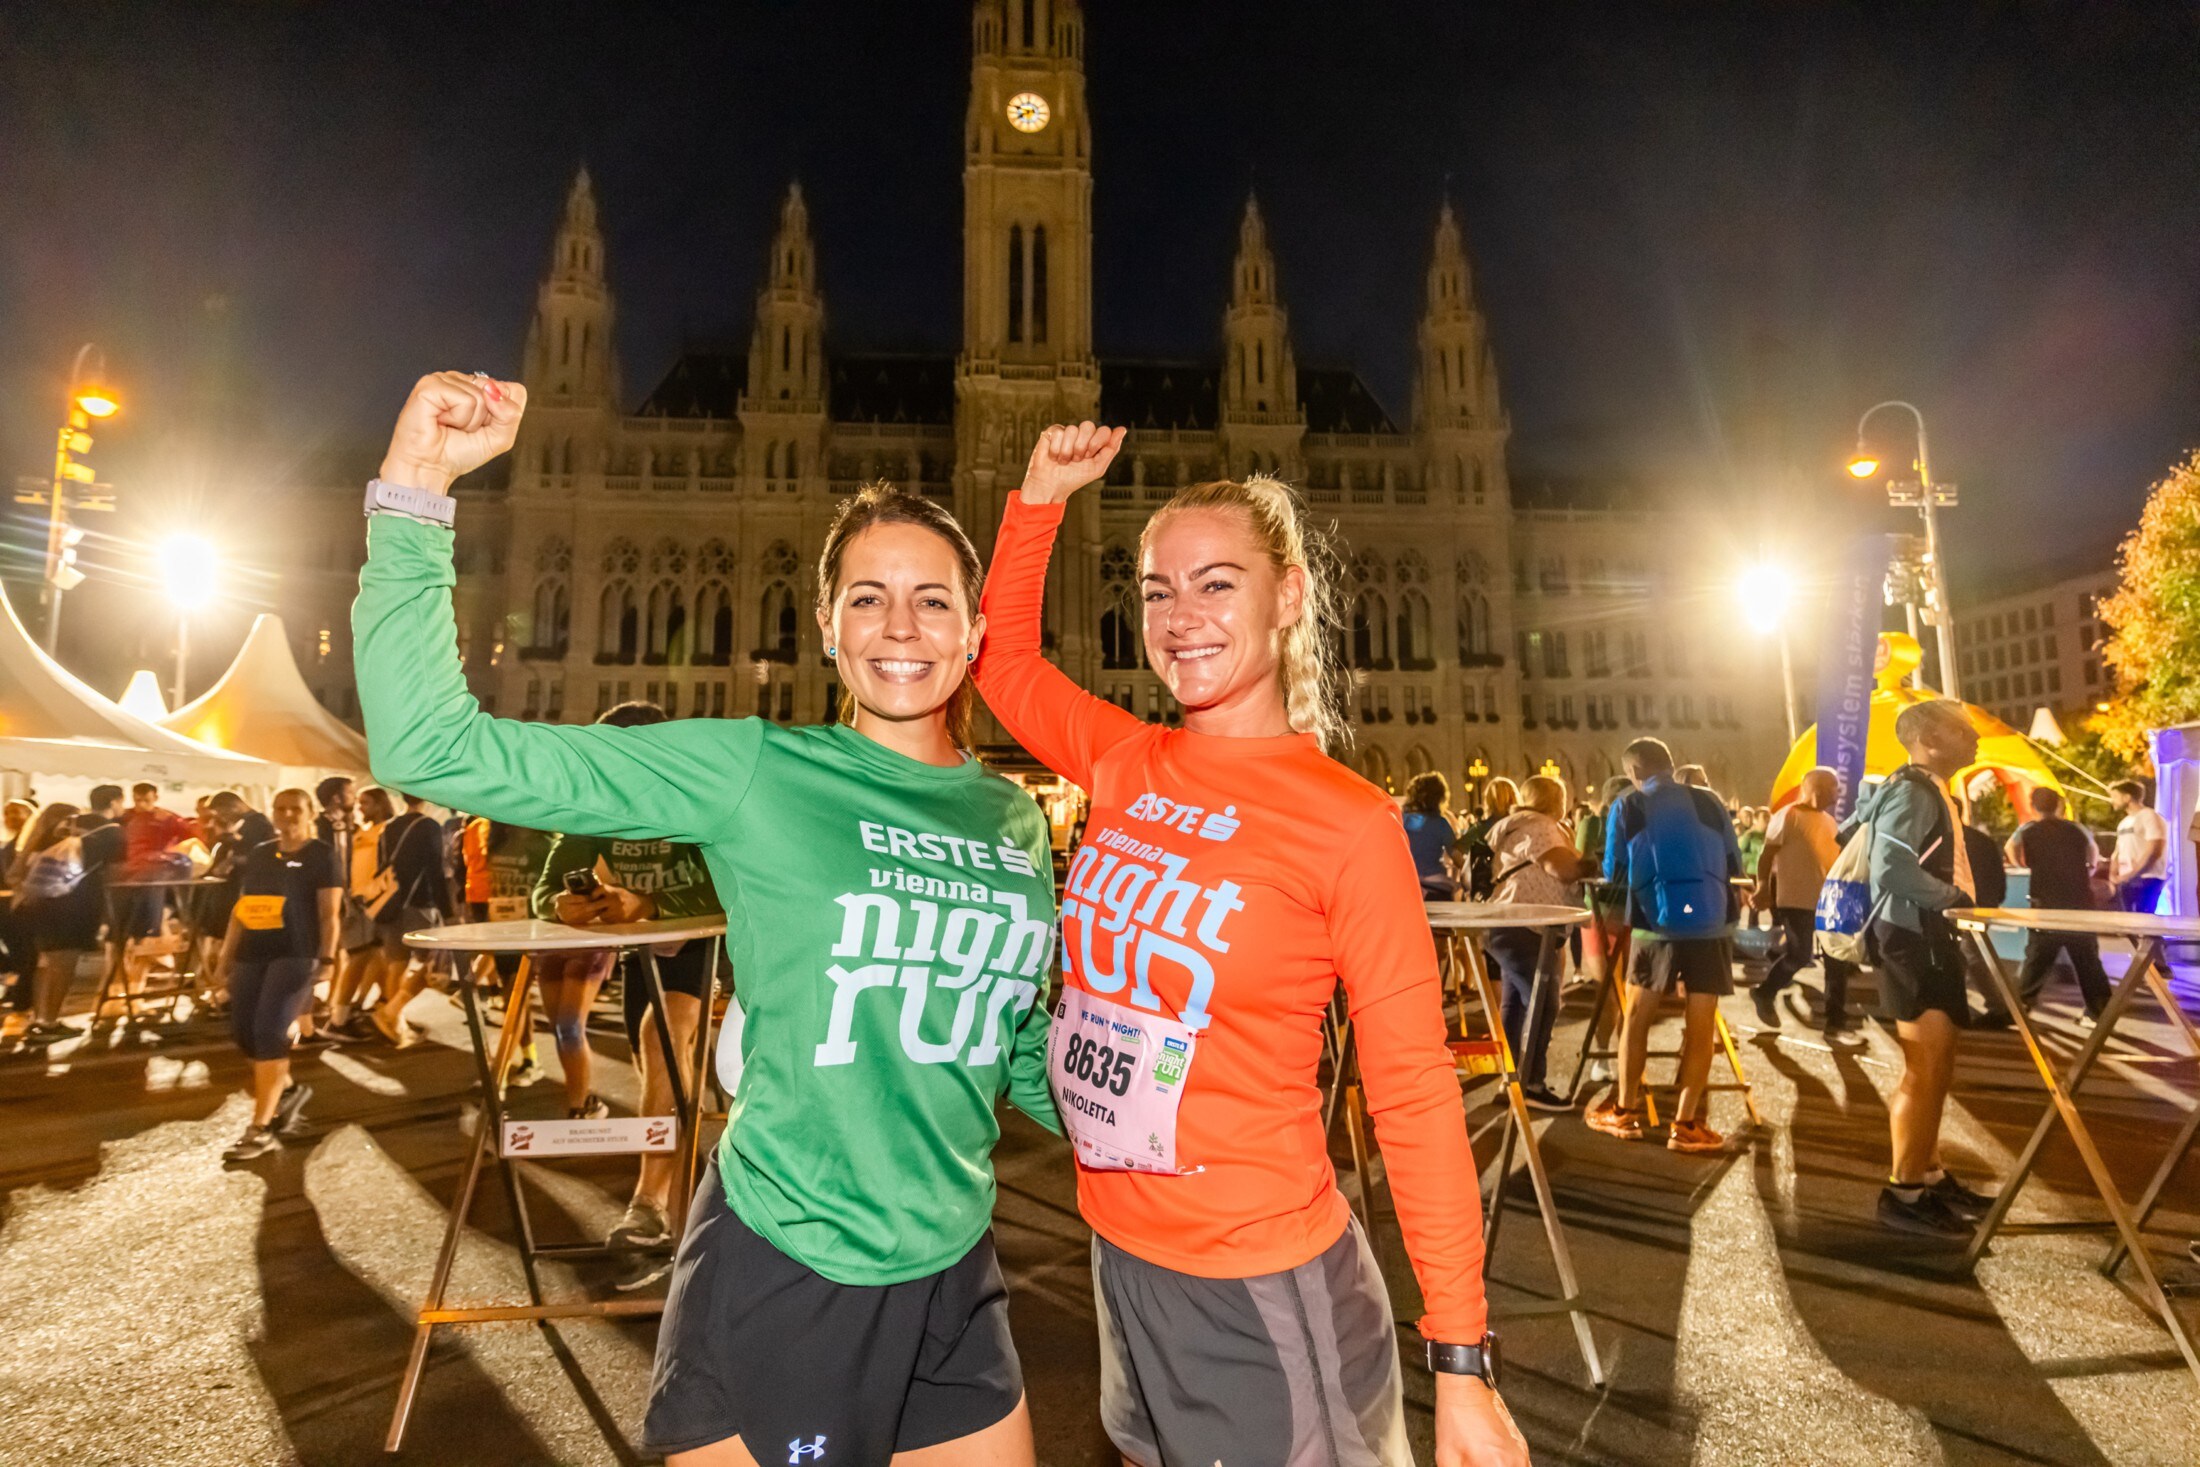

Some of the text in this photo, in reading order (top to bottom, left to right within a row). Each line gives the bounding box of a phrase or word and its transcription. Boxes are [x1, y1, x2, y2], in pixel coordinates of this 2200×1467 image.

[1125, 793, 1204, 834] ERSTE
[612, 841, 657, 856] ERSTE
[859, 821, 996, 870] ERSTE
[1096, 828, 1163, 861] vienna
[869, 868, 988, 903] vienna
[1065, 845, 1246, 954] night
[1062, 899, 1215, 1029] run
[814, 963, 1038, 1066] run
[1081, 1010, 1141, 1038] WE RUN NIGHT!
[1064, 1032, 1136, 1097] 8635
[1154, 1060, 1182, 1079] run
[1158, 1052, 1185, 1067] night
[1062, 1088, 1116, 1127] NIKOLETTA
